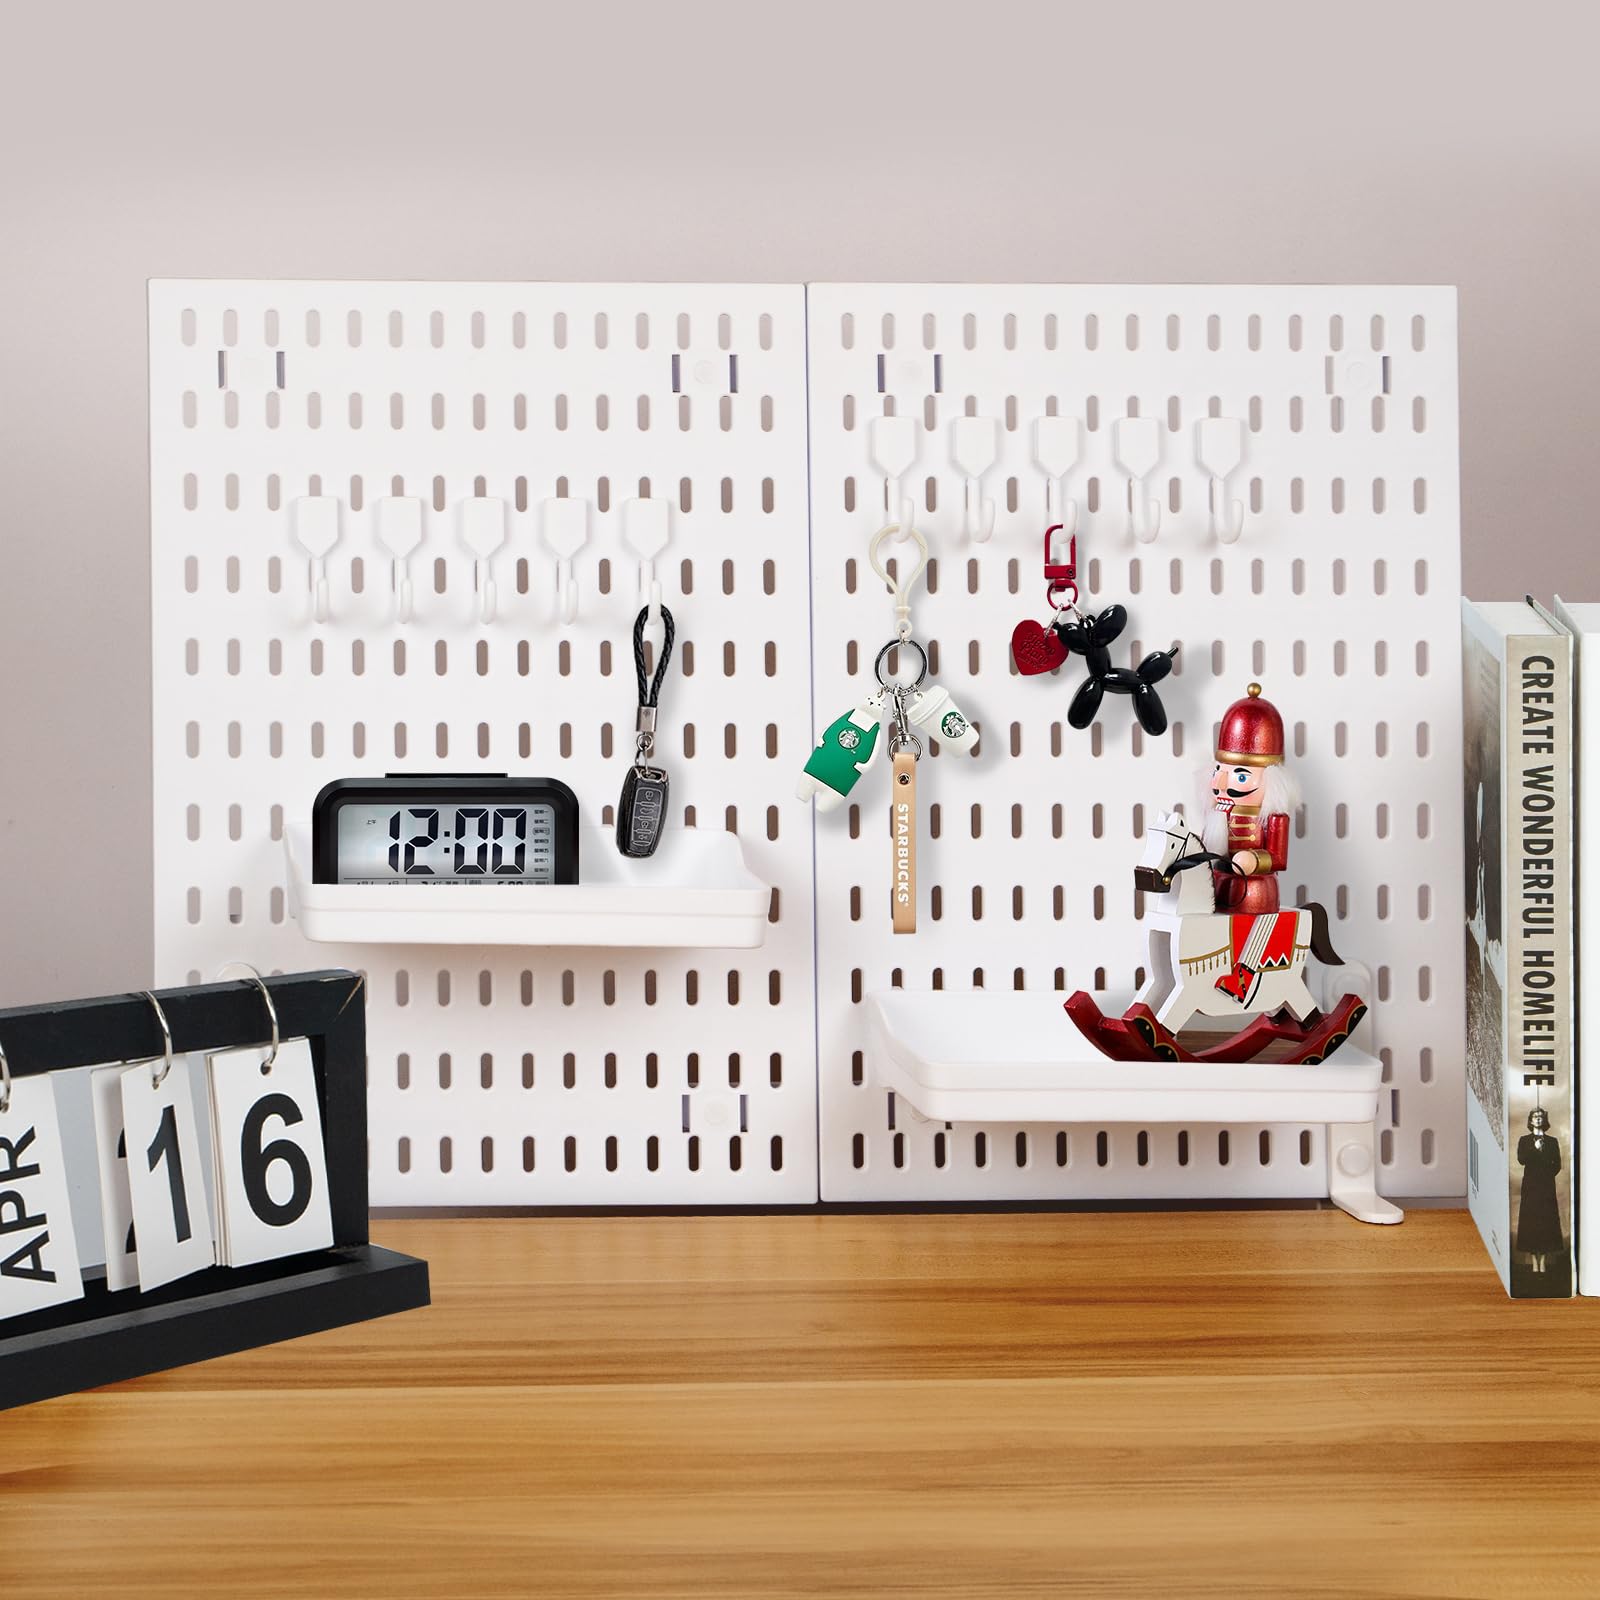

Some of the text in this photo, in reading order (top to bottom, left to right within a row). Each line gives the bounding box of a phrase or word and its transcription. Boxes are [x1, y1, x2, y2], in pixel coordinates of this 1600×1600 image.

[388, 808, 527, 875] 12:00
[896, 802, 909, 905] STARBUCKS
[1521, 655, 1557, 1086] CREATE WONDERFUL HOMELIFE
[0, 1126, 57, 1283] APR
[146, 1104, 193, 1243] 1
[241, 1093, 313, 1227] 6
